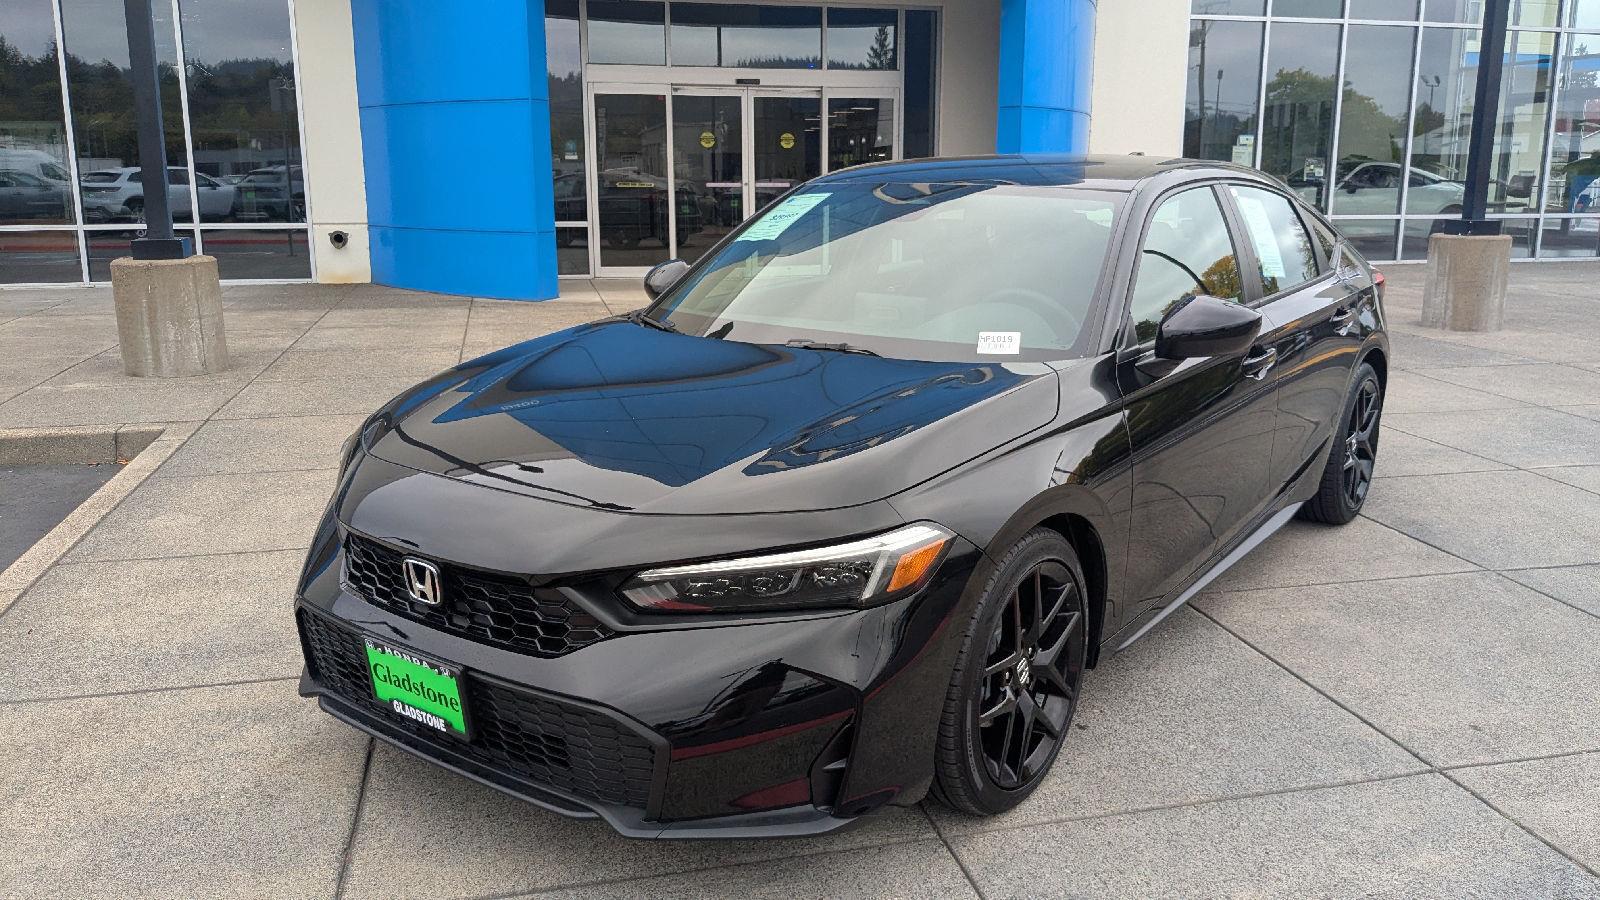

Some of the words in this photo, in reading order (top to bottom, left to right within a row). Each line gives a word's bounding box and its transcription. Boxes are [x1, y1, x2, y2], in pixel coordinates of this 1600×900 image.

[384, 646, 430, 669] HONDA
[373, 663, 459, 712] Gladstone
[393, 700, 447, 732] GLADSTONE
